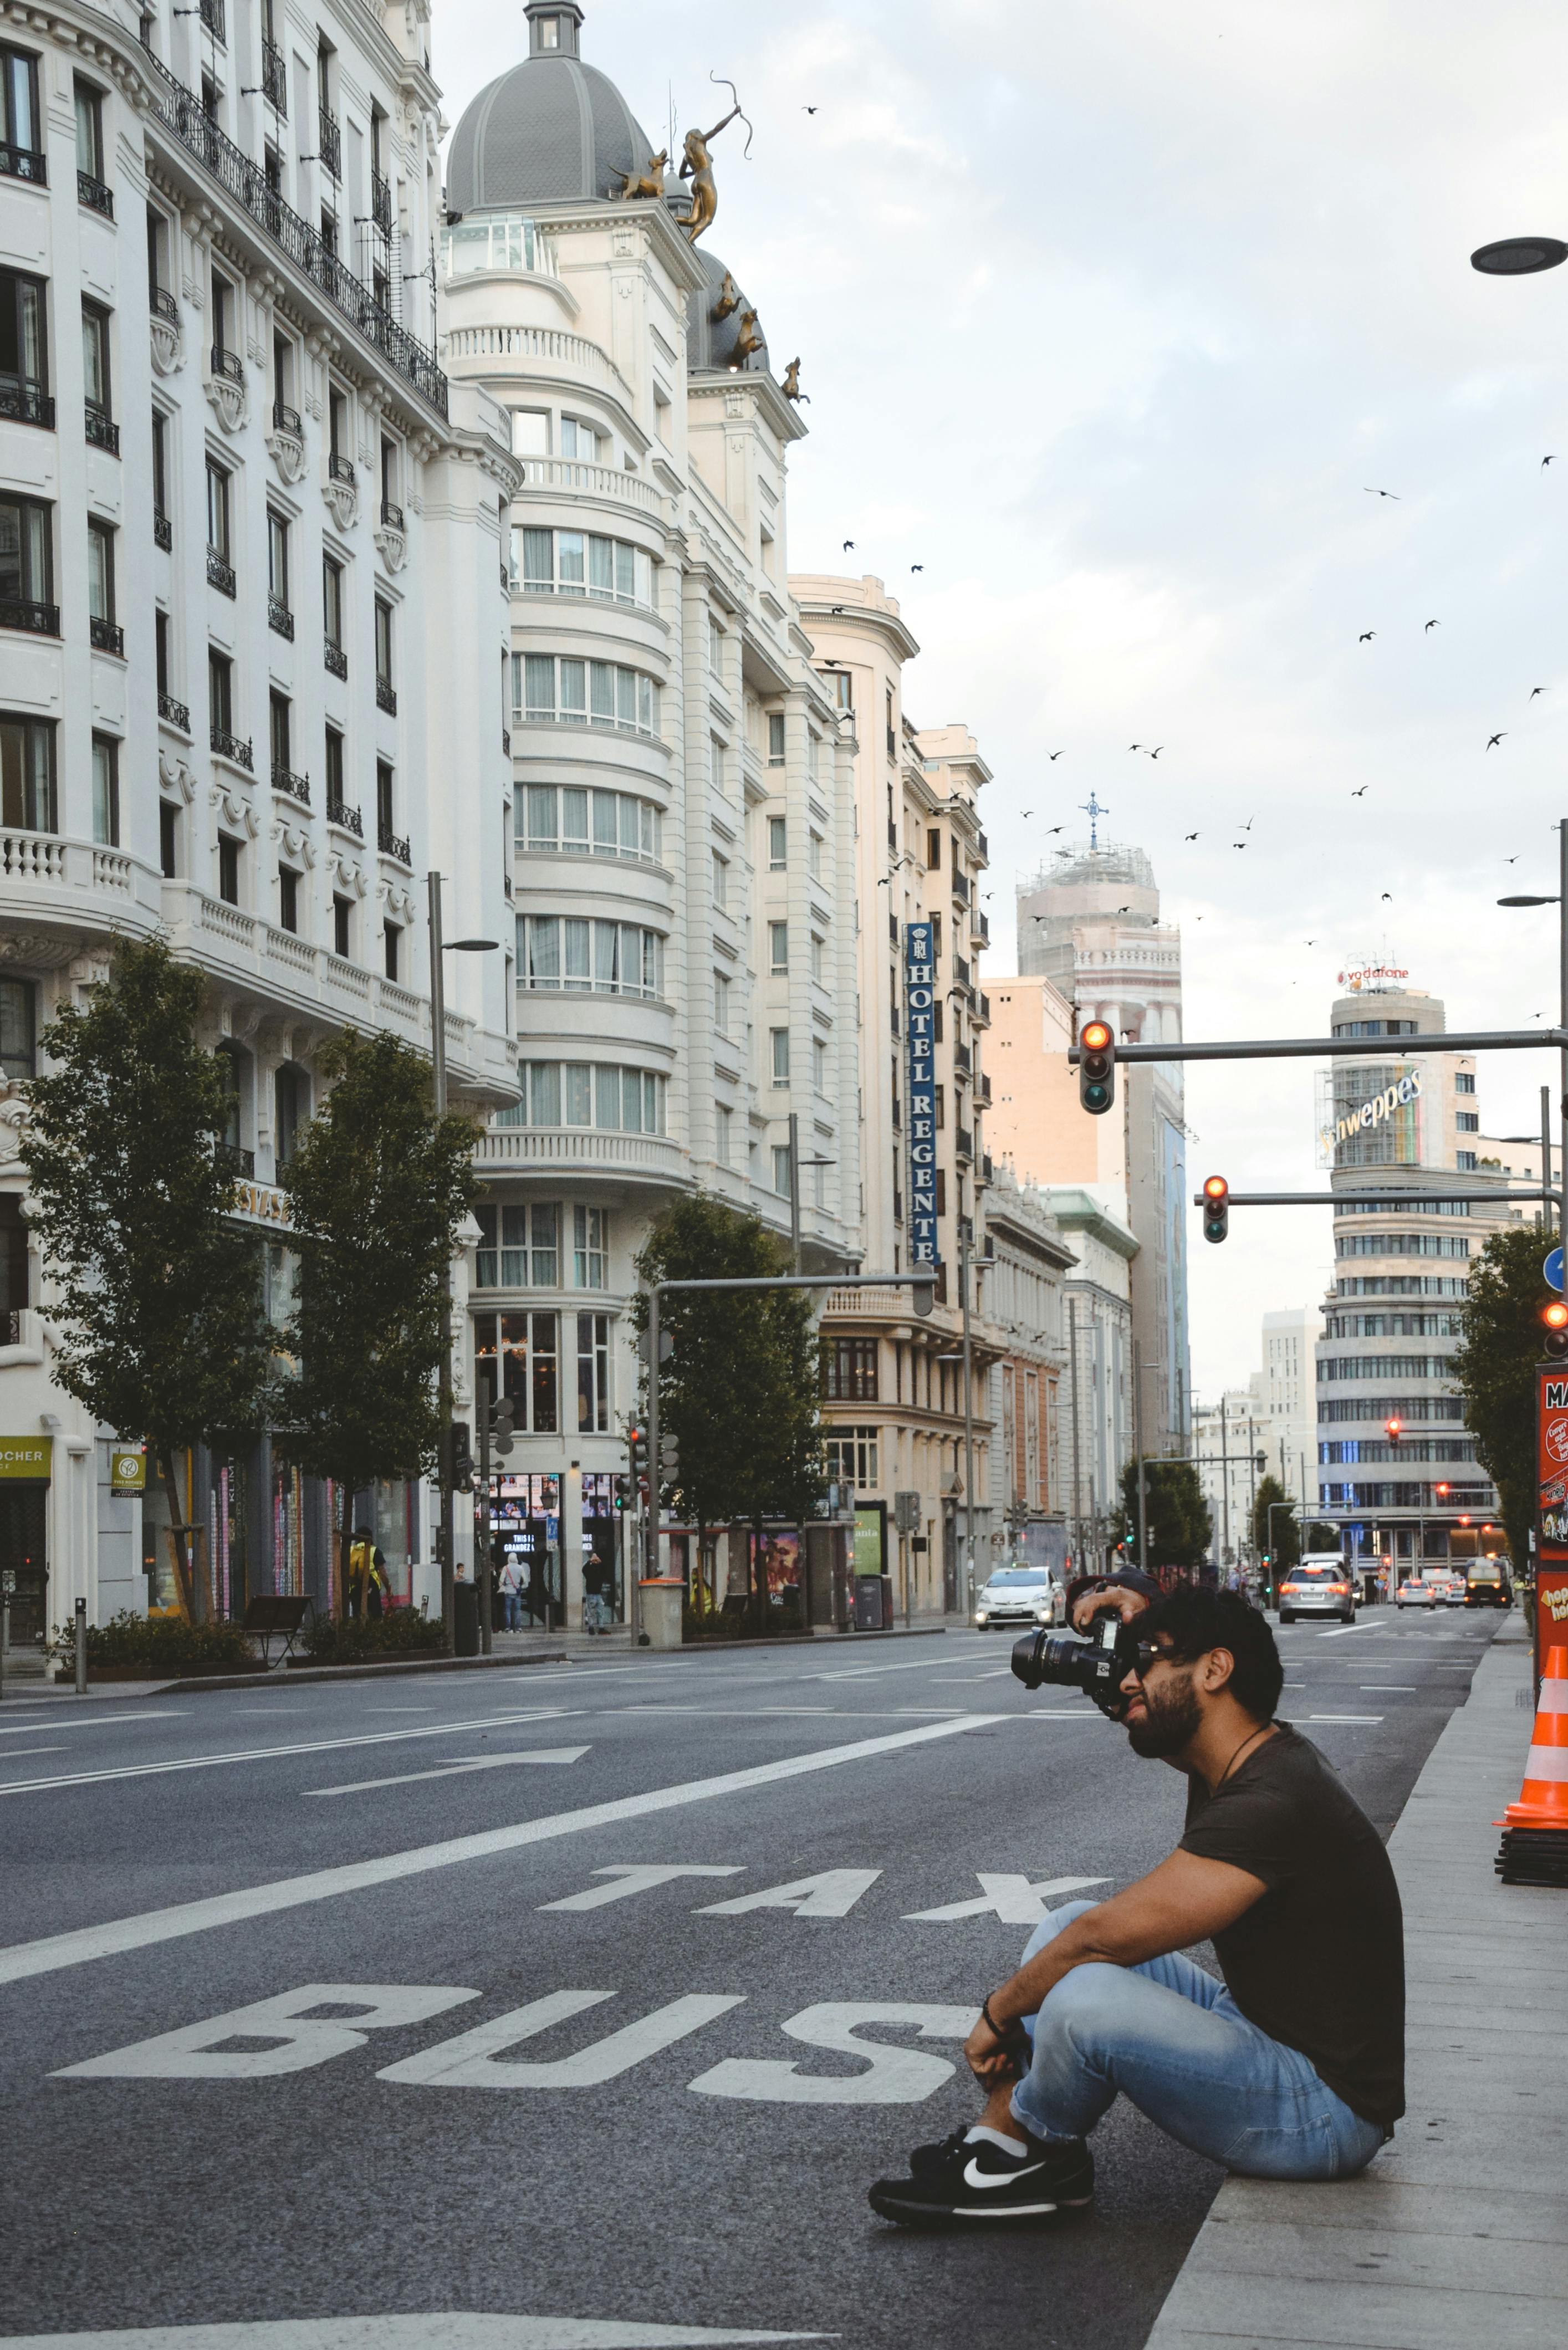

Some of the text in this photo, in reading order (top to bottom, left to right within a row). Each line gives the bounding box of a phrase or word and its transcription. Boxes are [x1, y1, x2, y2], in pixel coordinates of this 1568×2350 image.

[1347, 966, 1408, 980] vodafone
[908, 965, 934, 1261] HOTEL REGENTE
[1318, 1069, 1422, 1157] Schweppes
[1547, 1484, 1565, 1500] MADRID
[513, 1534, 527, 1542] THIS
[1551, 1604, 1568, 1622] ho
[47, 1984, 983, 2104] BUS
